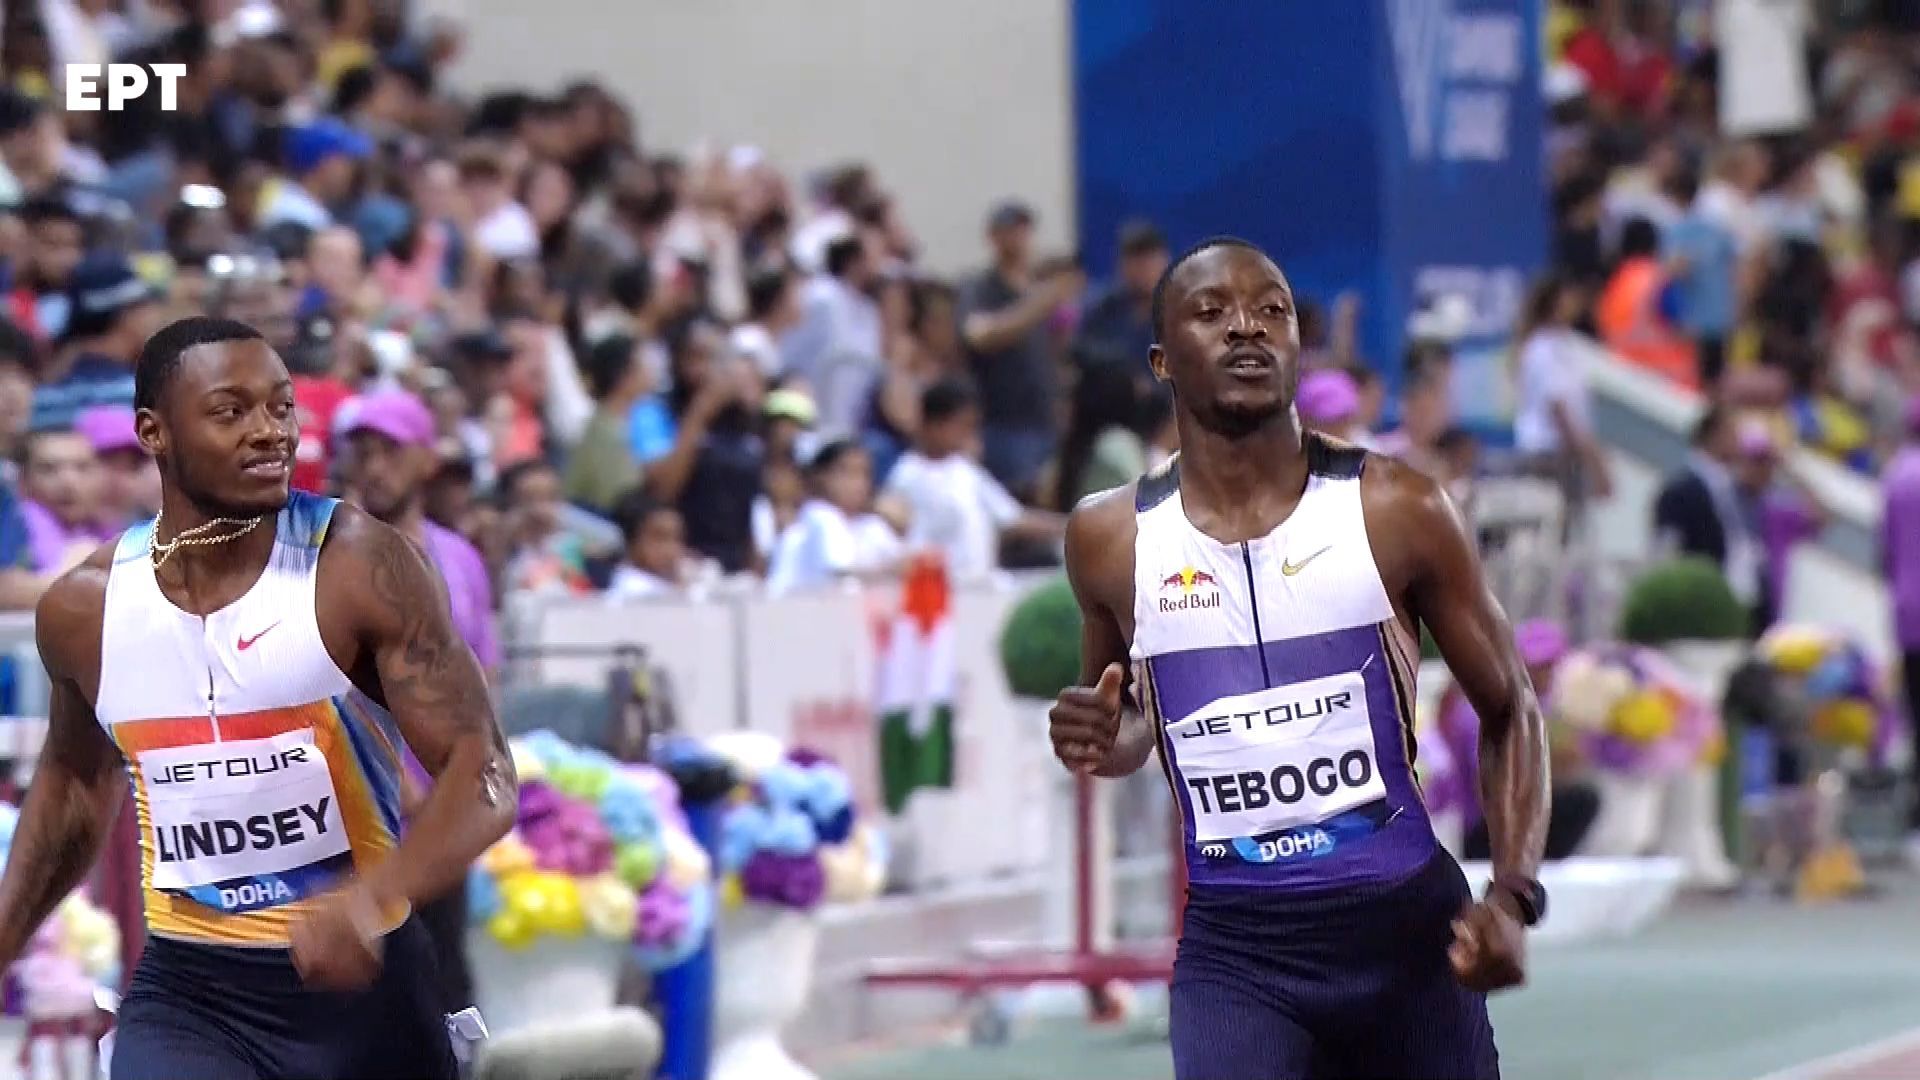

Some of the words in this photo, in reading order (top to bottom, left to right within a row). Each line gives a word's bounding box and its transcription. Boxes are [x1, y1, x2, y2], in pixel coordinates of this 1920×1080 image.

[1160, 594, 1188, 612] Red
[1191, 592, 1220, 608] Bull
[1182, 692, 1351, 738] JETOUR
[153, 748, 309, 784] JETOUR
[1188, 750, 1371, 814] TEBOGO
[156, 796, 330, 862] LINDSEY
[1259, 829, 1331, 862] DOHA
[219, 880, 293, 909] DOHA
